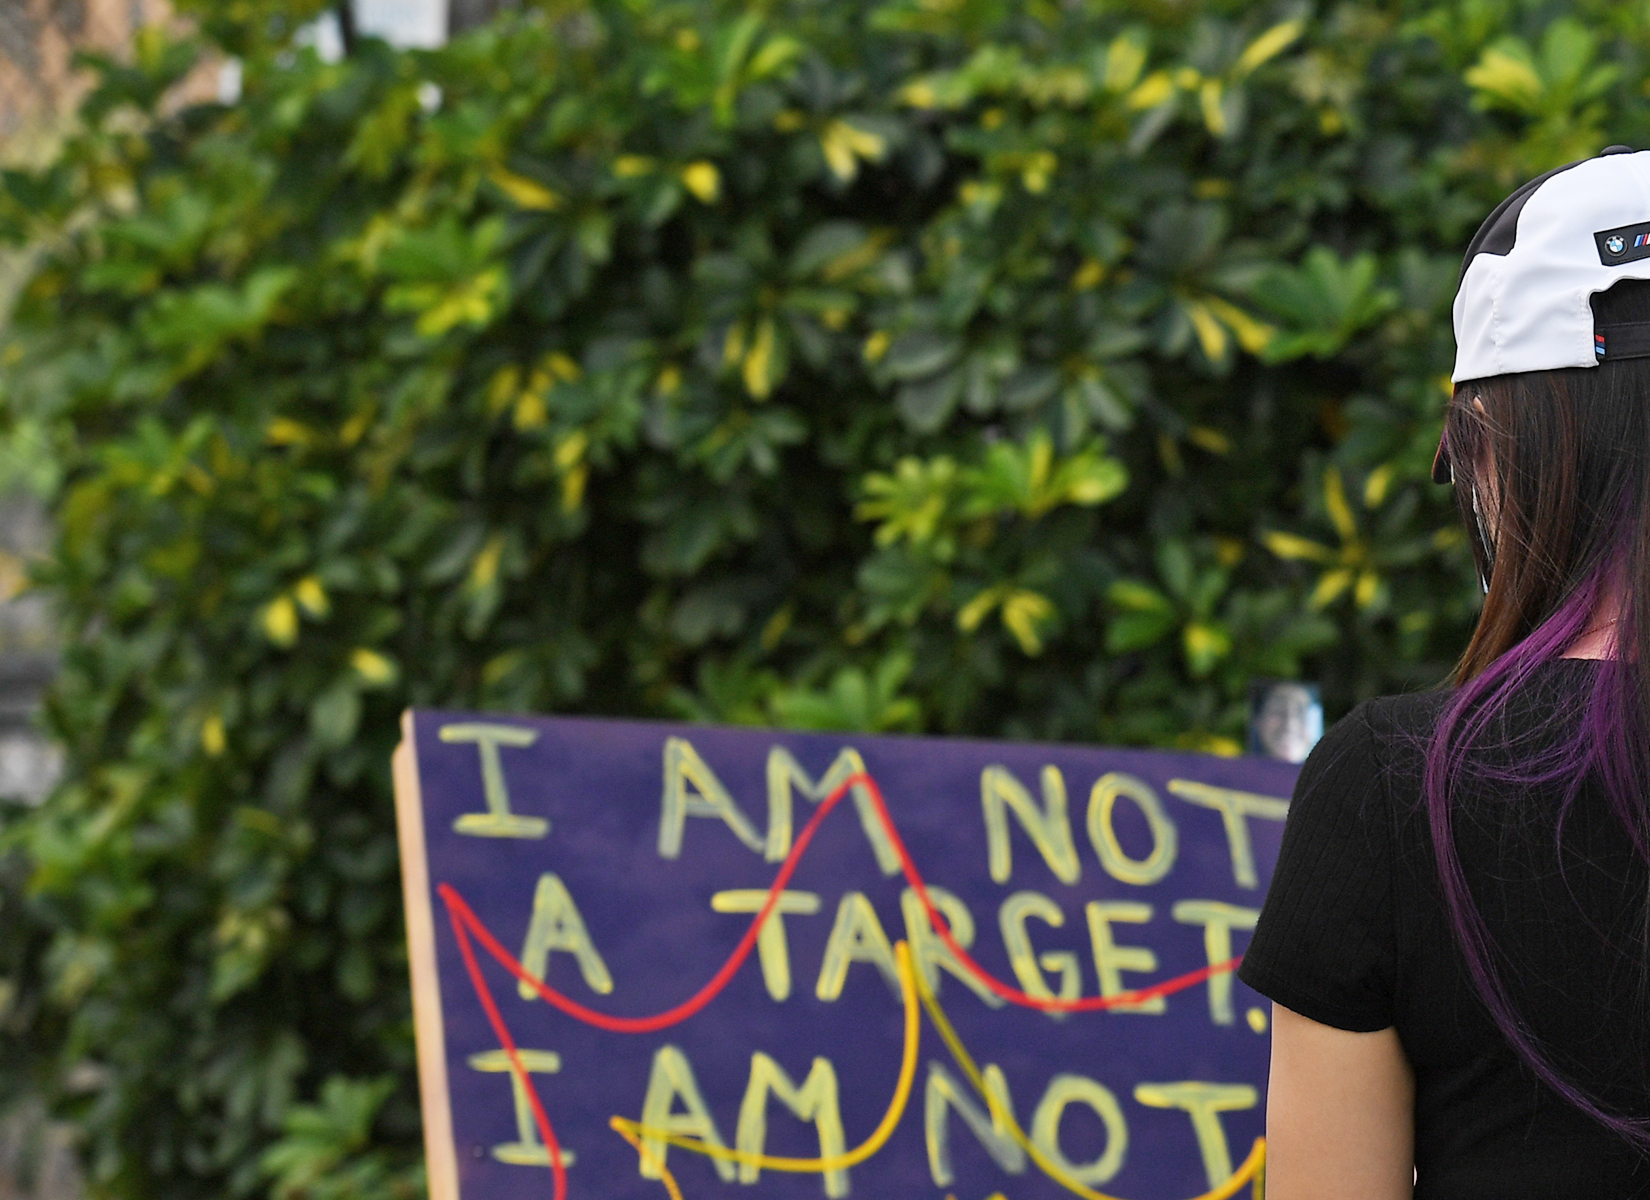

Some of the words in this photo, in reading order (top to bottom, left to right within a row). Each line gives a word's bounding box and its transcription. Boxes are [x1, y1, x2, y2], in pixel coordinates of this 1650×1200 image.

[438, 725, 551, 838] I
[659, 738, 901, 874] AM
[981, 763, 1290, 889] NOT
[518, 872, 614, 998] A
[468, 1050, 576, 1166] I
[638, 1045, 851, 1198] AM
[924, 1062, 1258, 1190] NOT
